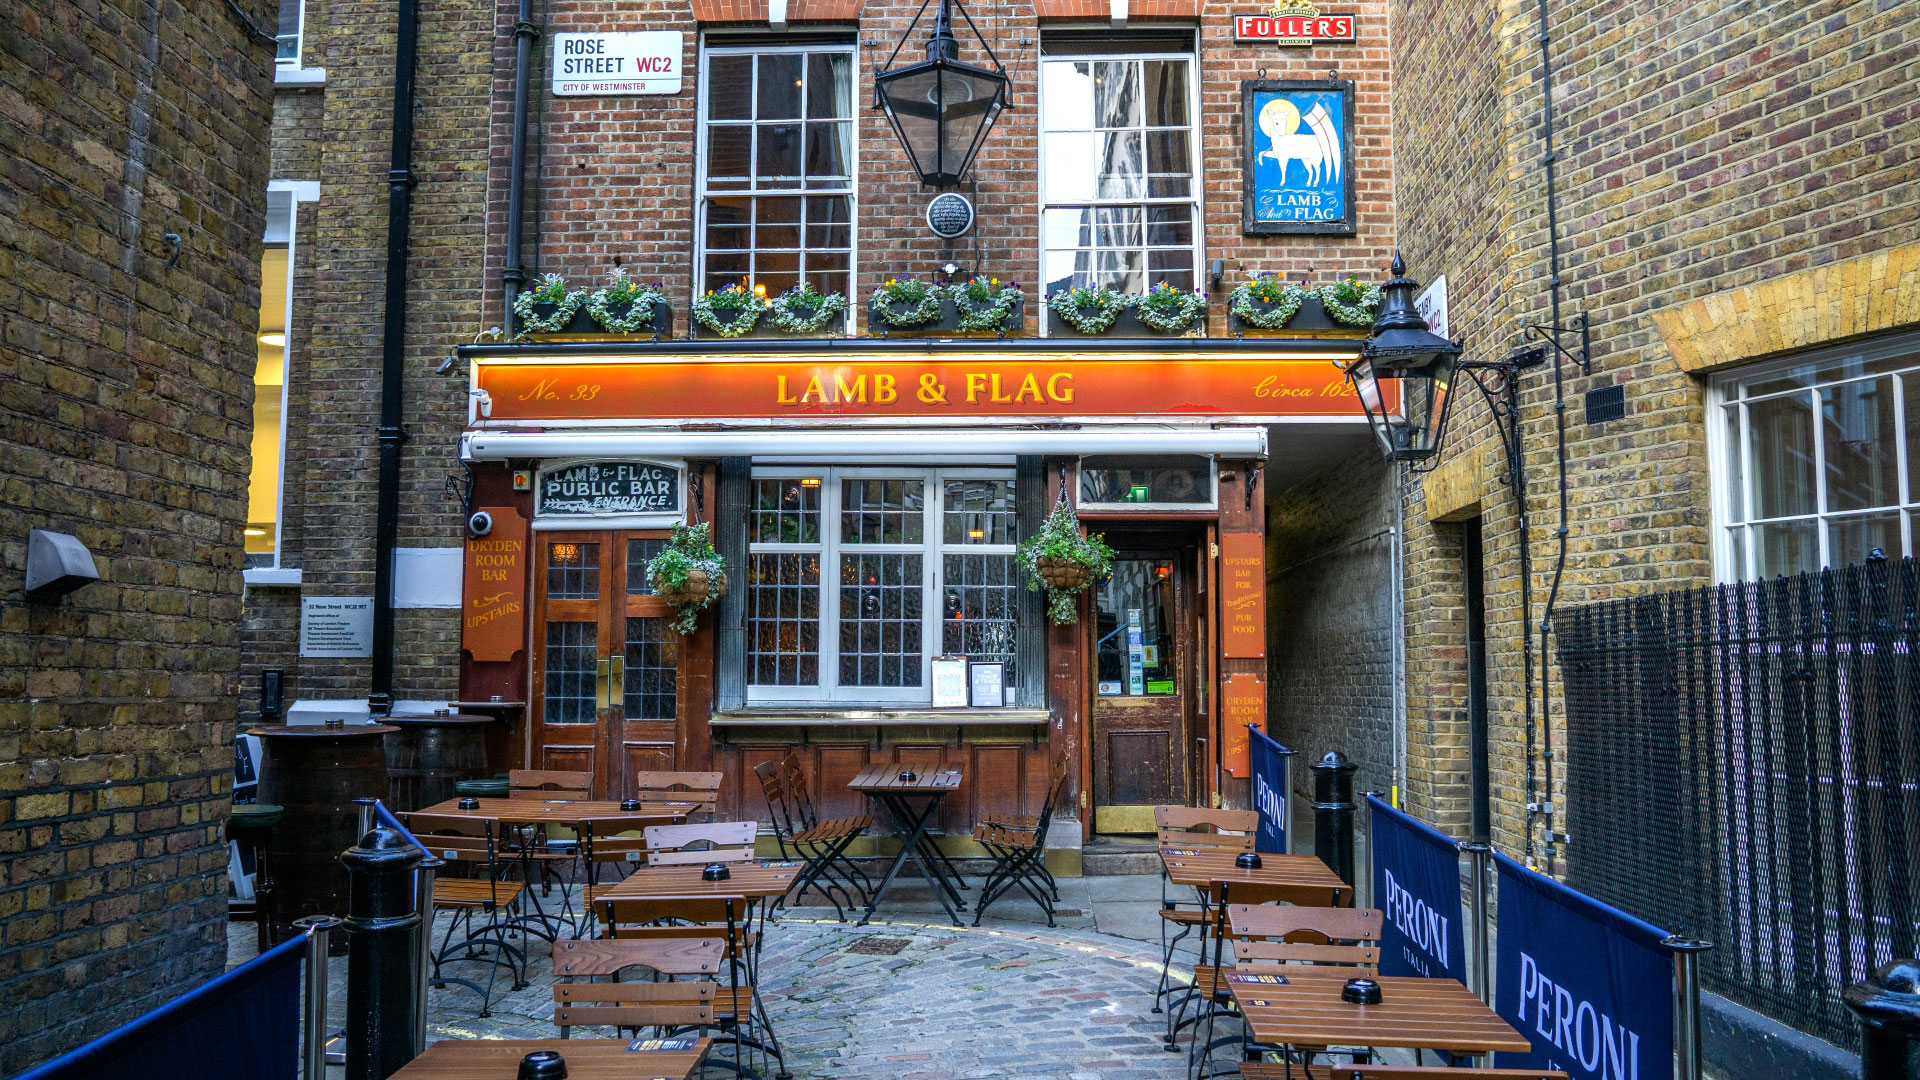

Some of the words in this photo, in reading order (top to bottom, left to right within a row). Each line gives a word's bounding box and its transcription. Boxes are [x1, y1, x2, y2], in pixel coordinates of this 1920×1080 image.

[1242, 18, 1347, 38] FULLER'S
[564, 39, 605, 55] ROSE
[563, 57, 624, 73] STREET
[636, 57, 672, 73] WC2
[592, 82, 646, 91] WESTMINSTER
[1277, 194, 1321, 206] LAMB
[1294, 207, 1334, 219] FLAG
[518, 379, 560, 401] No.
[569, 384, 601, 401] 33
[777, 374, 898, 403] LAMB
[916, 373, 948, 403] &
[965, 372, 1074, 403] FLAG
[1251, 375, 1315, 398] Circa
[555, 465, 600, 482] LAMB
[547, 481, 619, 497] PUBLIC
[630, 481, 670, 495] BAR
[469, 540, 522, 552] DRYDEN
[475, 554, 515, 567] ROOM
[1225, 558, 1261, 566] UPSTAIRS
[482, 569, 508, 581] BAR
[1235, 569, 1251, 577] BAR
[1235, 581, 1251, 589] FOR
[1226, 591, 1261, 607] Traditional
[467, 602, 520, 628] UPSTAIRS
[1226, 697, 1262, 705] DRYDEN
[1230, 706, 1259, 715] ROOM
[1235, 716, 1253, 724] BAR
[1226, 743, 1249, 756] UPST
[1384, 868, 1449, 970] PERONI
[1403, 945, 1430, 978] ITALIA
[1518, 951, 1640, 1080] PERONI
